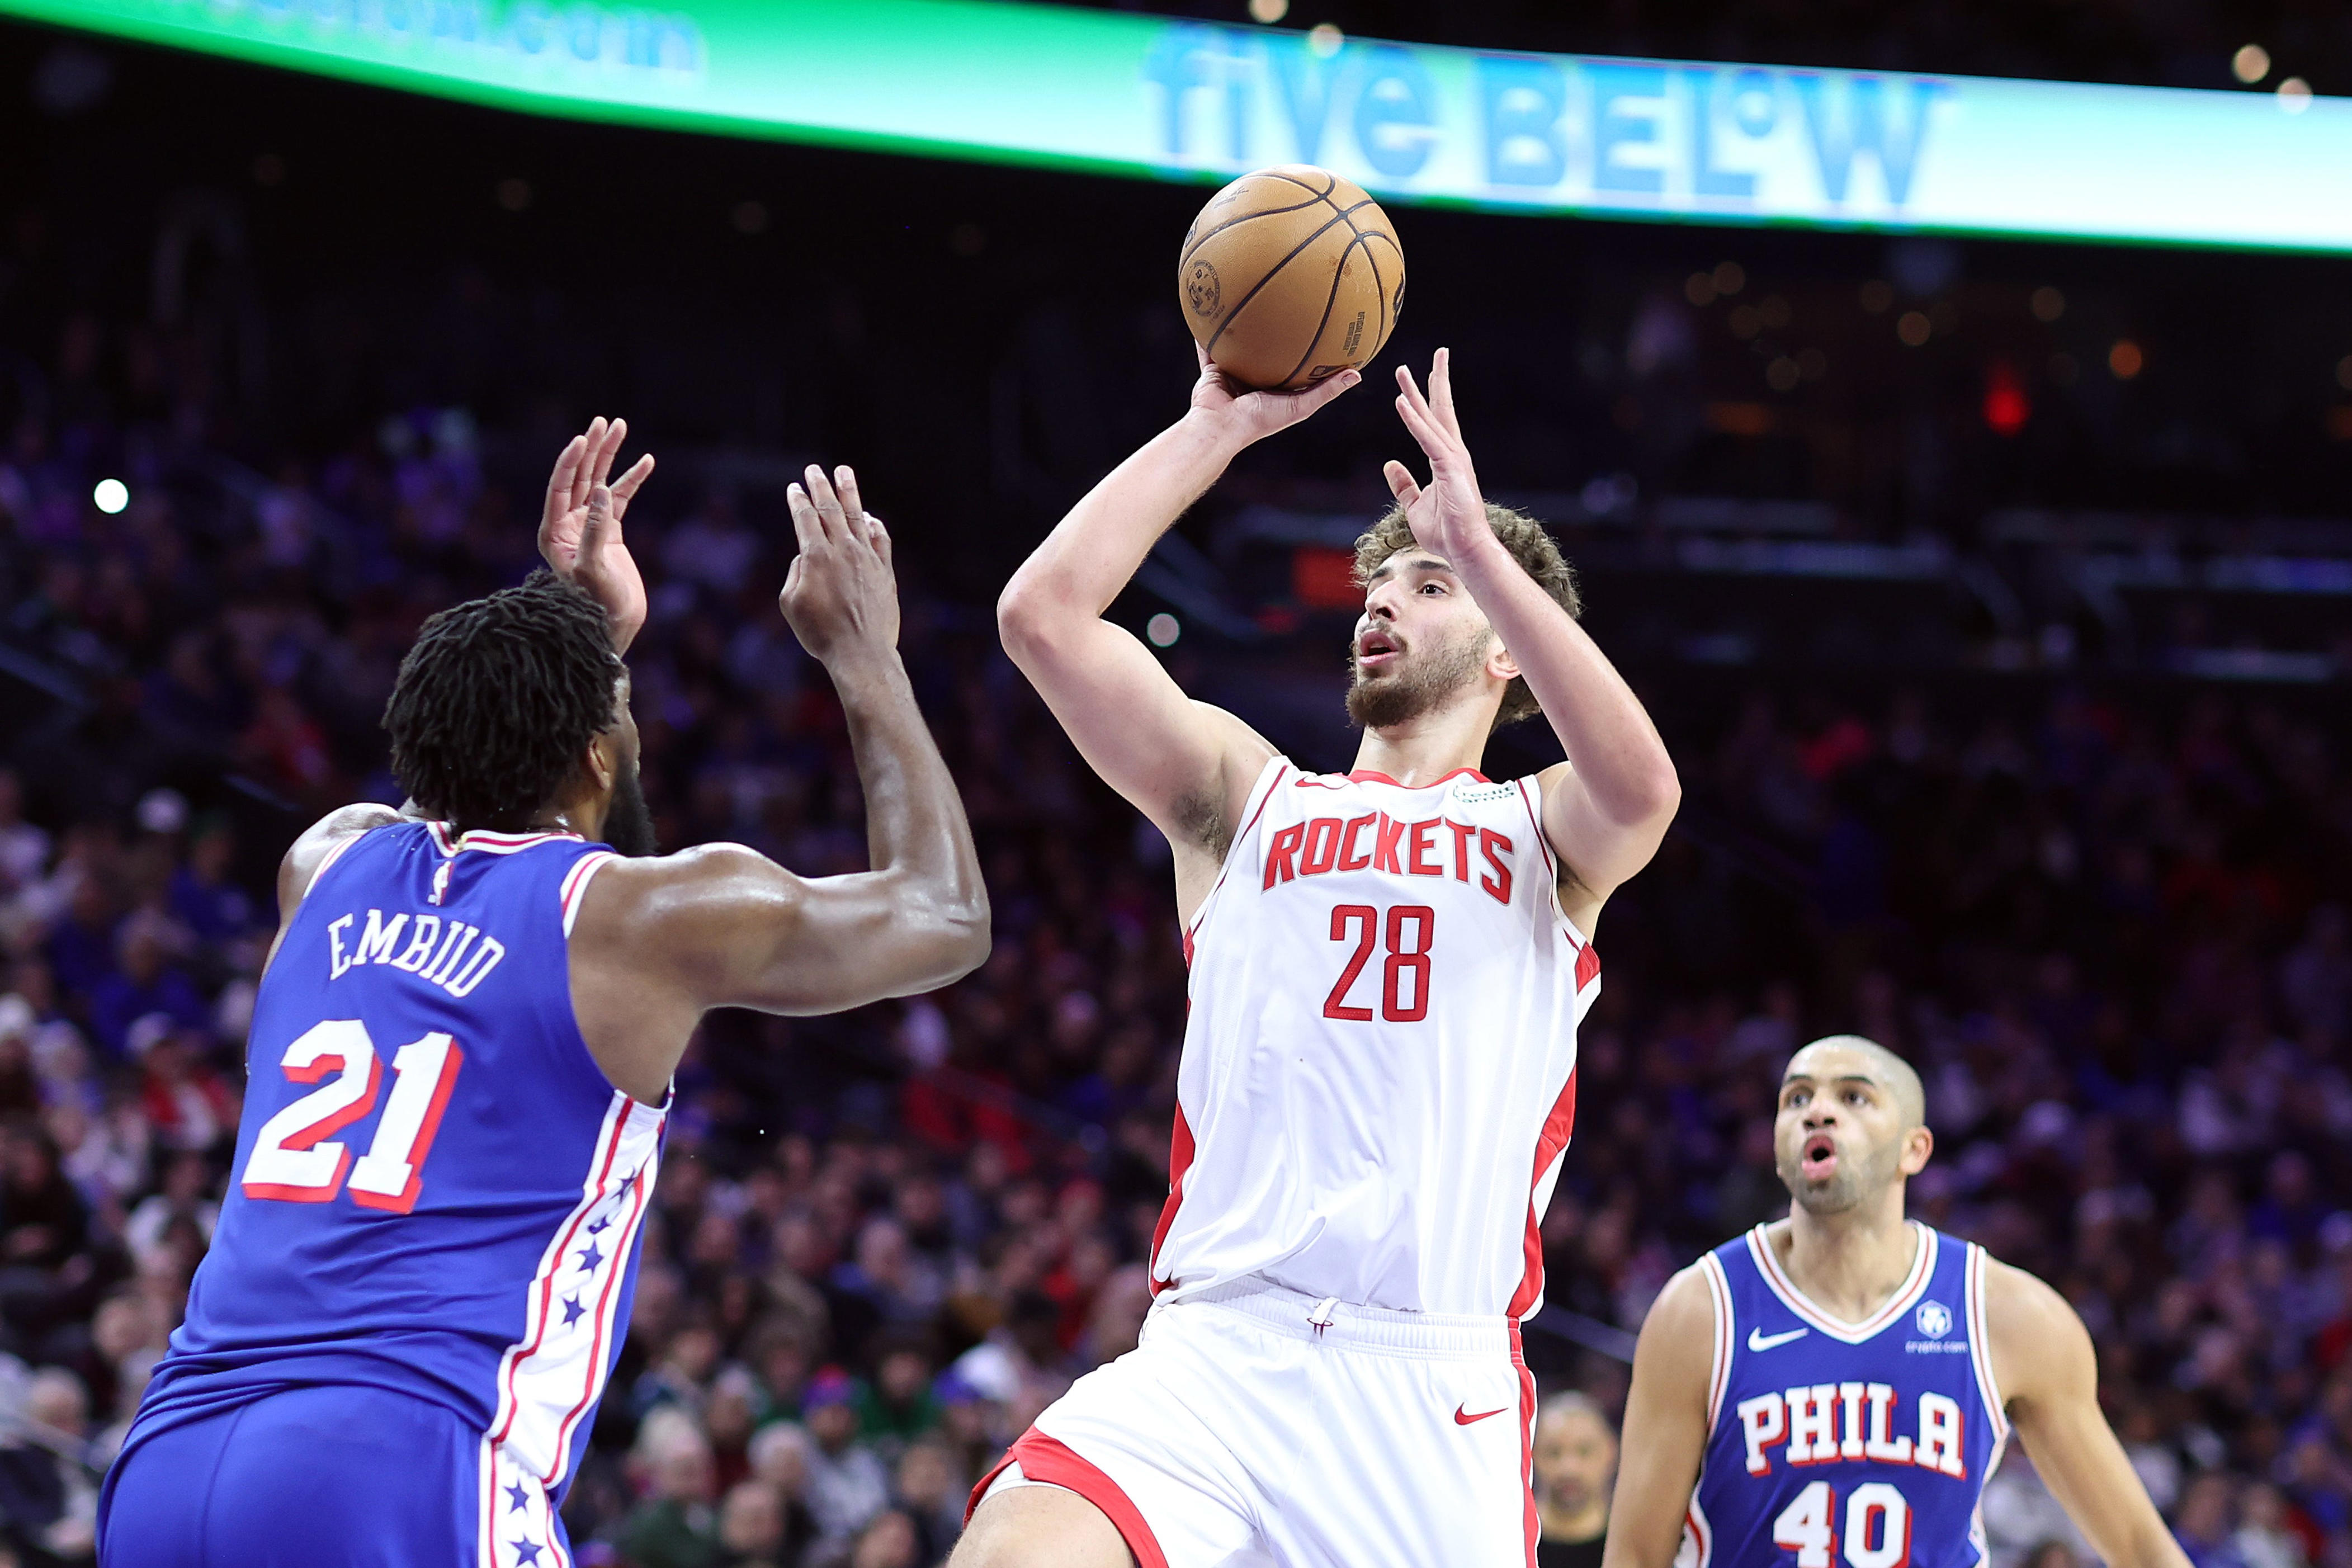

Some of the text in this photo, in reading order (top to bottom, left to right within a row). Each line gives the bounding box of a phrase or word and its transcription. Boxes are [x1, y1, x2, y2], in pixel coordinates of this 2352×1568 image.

[1146, 21, 1438, 177] five
[1262, 810, 1514, 906] ROCKETS
[328, 910, 504, 998] EMBIID
[1323, 905, 1434, 1022] 28
[241, 1019, 462, 1213] 21
[1737, 1382, 1966, 1480] PHILA
[1773, 1480, 1912, 1568] 40
